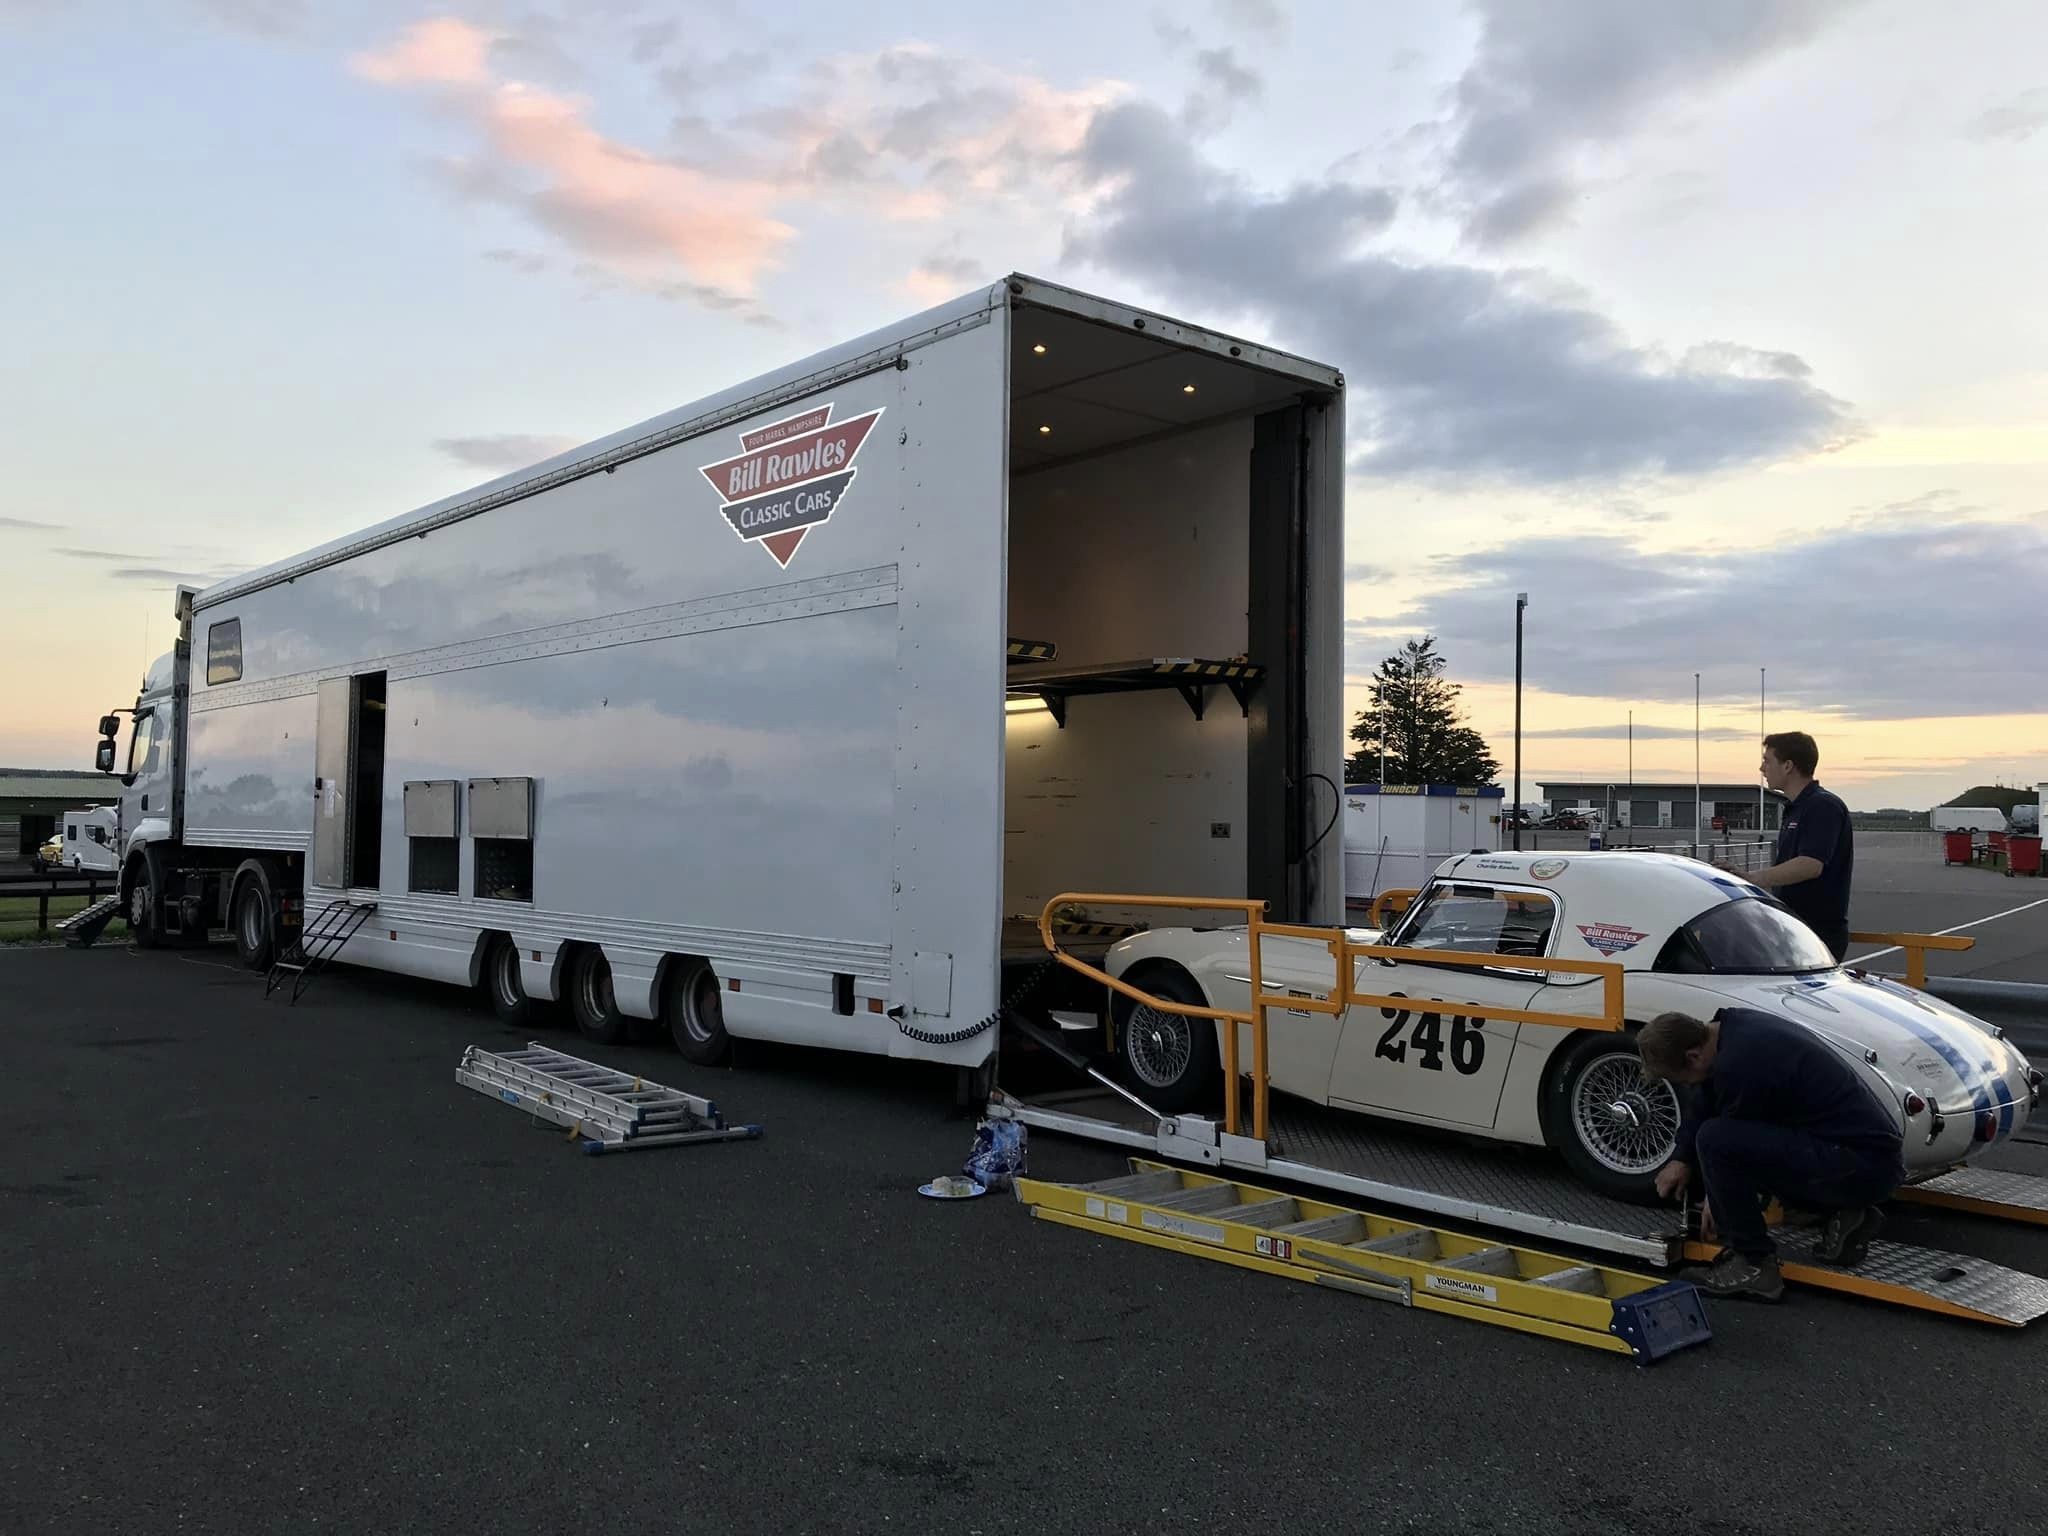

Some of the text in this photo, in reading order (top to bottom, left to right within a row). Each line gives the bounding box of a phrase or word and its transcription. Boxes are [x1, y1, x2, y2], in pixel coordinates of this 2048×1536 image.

[728, 438, 847, 496] Bill Rawles
[740, 490, 832, 529] CLASSIC CARS
[1379, 785, 1419, 794] SUNOCO
[1586, 927, 1602, 937] Bill
[1603, 930, 1638, 942] Rawles
[1375, 991, 1485, 1075] 246
[1436, 1277, 1485, 1294] YOUNGMAN
